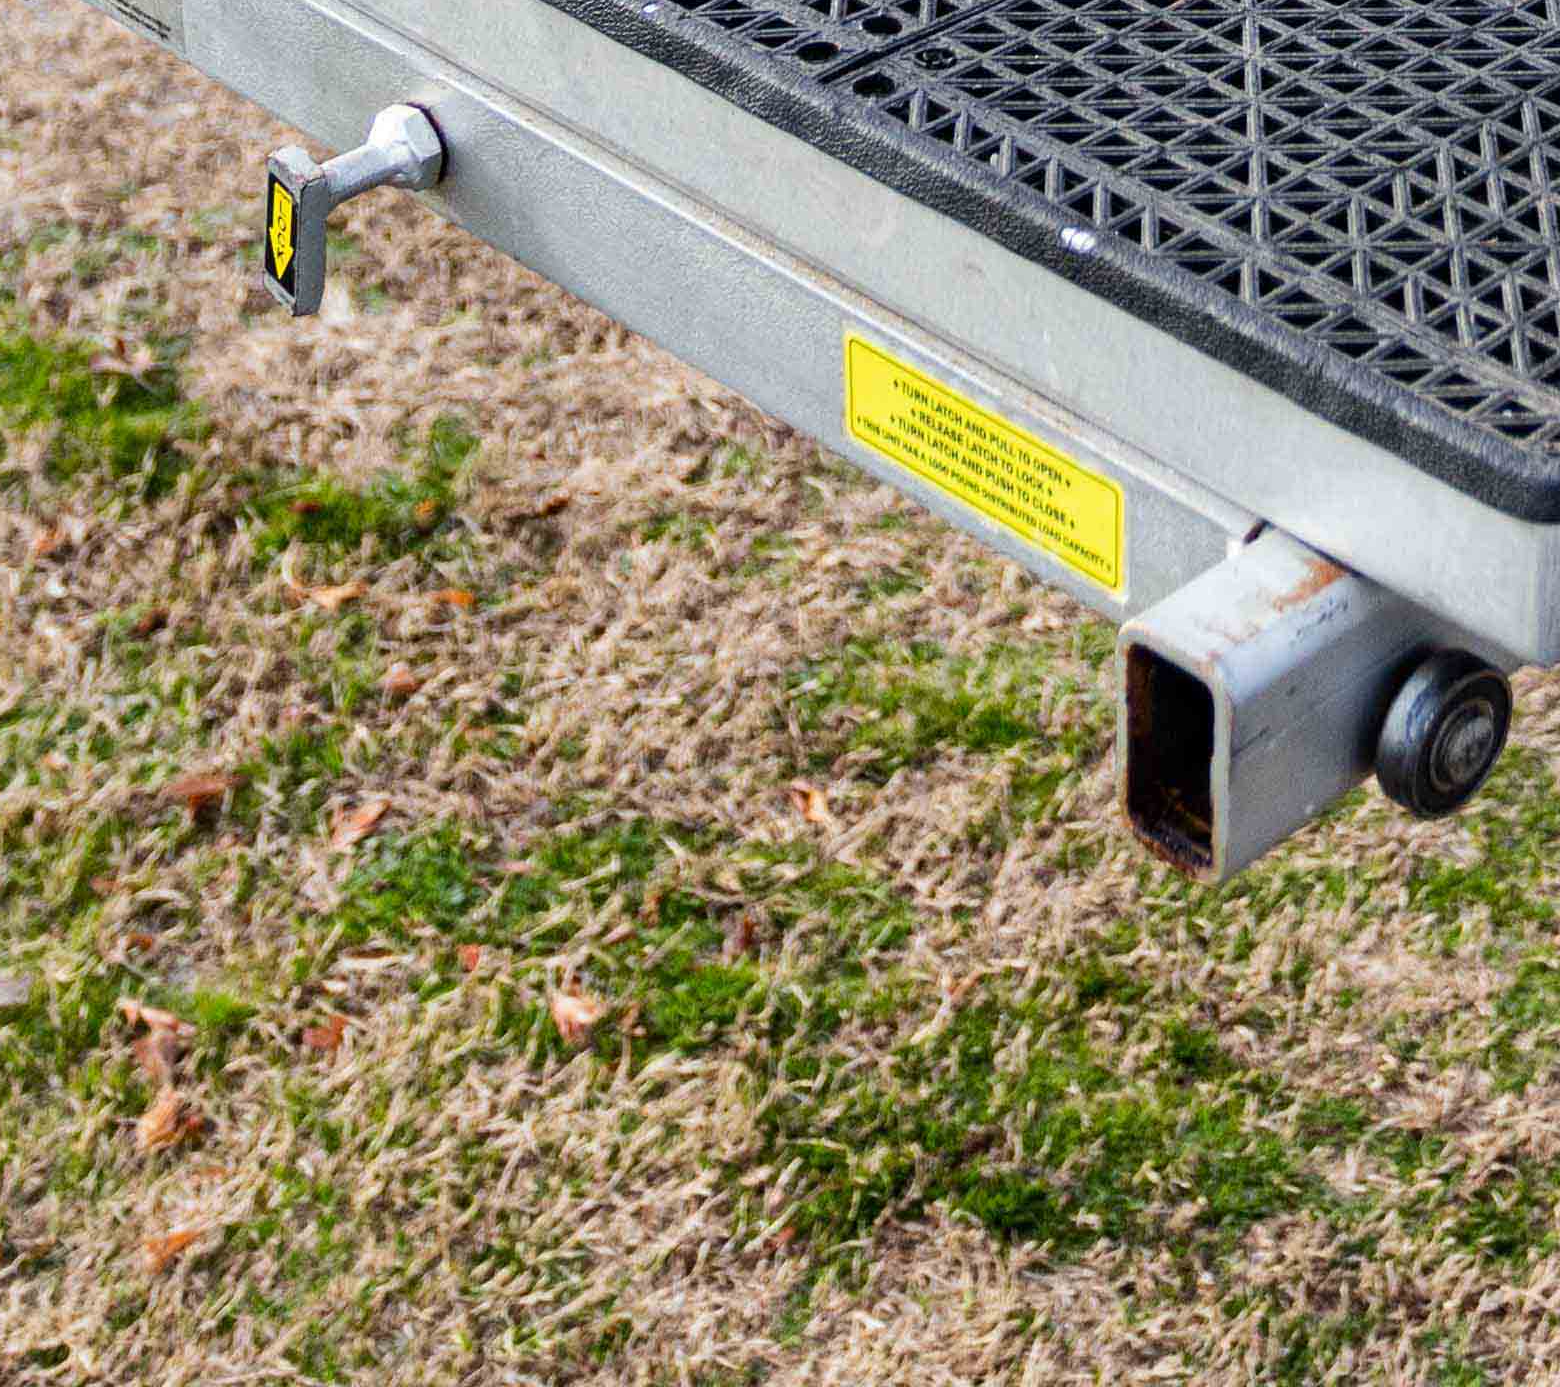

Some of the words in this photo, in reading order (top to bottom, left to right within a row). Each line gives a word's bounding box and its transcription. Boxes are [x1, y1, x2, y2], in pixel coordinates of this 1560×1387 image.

[899, 416, 925, 441] TURN
[927, 433, 959, 462] LATCH
[961, 454, 983, 476] AND
[985, 469, 1014, 496] PUSH
[1017, 485, 1030, 503] TO
[1032, 495, 1066, 525] CLOSE
[902, 380, 928, 406] TURN
[931, 395, 962, 427] LATCH
[965, 418, 986, 441] AND
[989, 430, 1017, 458] PULL
[1018, 449, 1031, 466] TO
[1033, 457, 1062, 484] OPEN
[919, 410, 963, 445] RELEASE
[966, 435, 998, 466] LATCH
[1001, 458, 1013, 475] TO
[1016, 466, 1045, 493] LOCK
